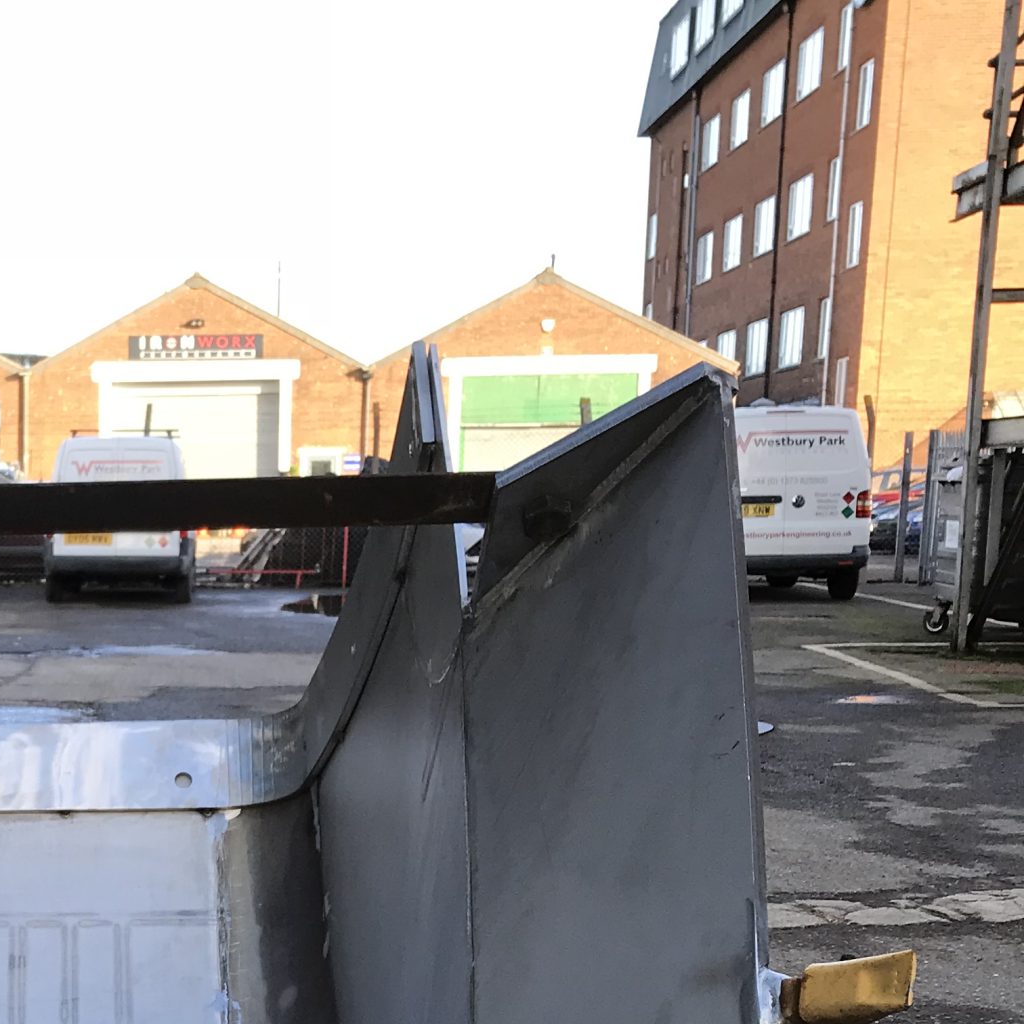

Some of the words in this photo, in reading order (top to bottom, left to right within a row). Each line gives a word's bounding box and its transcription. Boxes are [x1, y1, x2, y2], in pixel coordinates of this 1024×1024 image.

[753, 436, 815, 448] Westbury
[819, 435, 846, 446] Park
[744, 530, 852, 540] stburyparkengineering.co.uk
